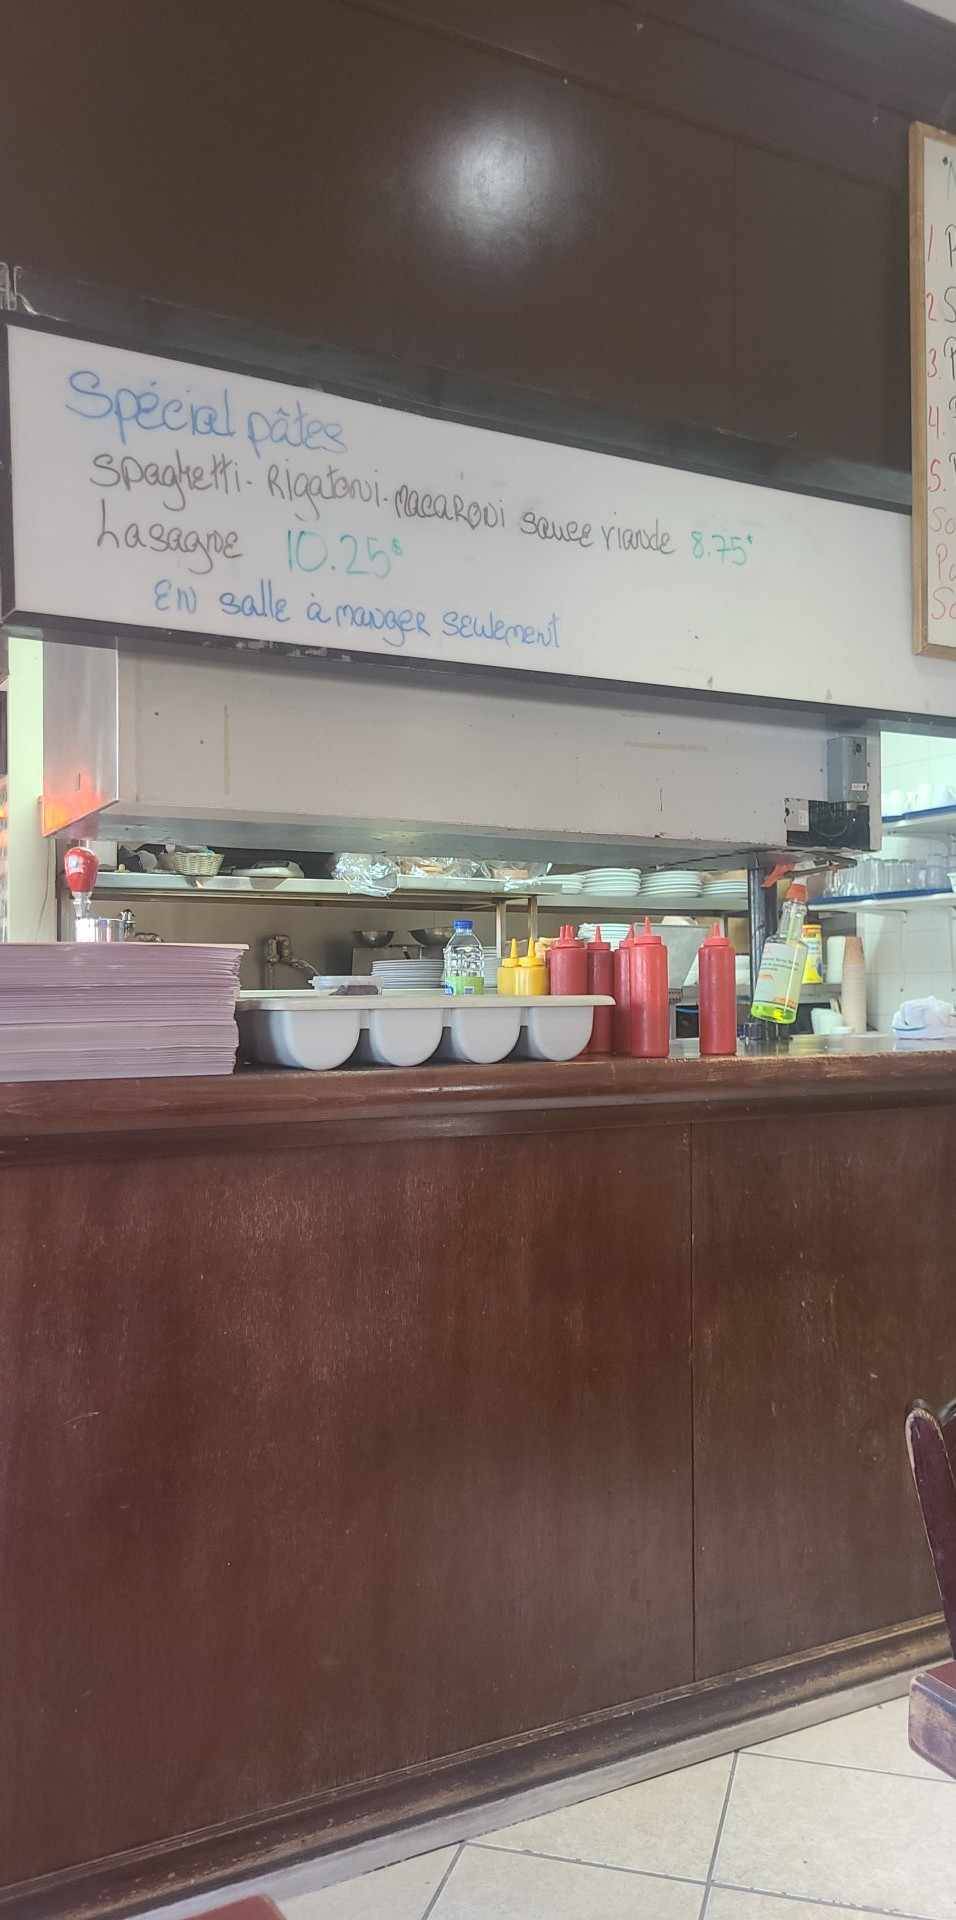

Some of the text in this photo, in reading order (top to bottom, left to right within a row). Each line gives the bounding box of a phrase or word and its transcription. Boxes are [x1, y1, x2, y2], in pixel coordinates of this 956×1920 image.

[248, 401, 347, 457] pâtes
[97, 499, 243, 575] Lasagne
[520, 511, 594, 548] sauce
[218, 578, 292, 623] salle
